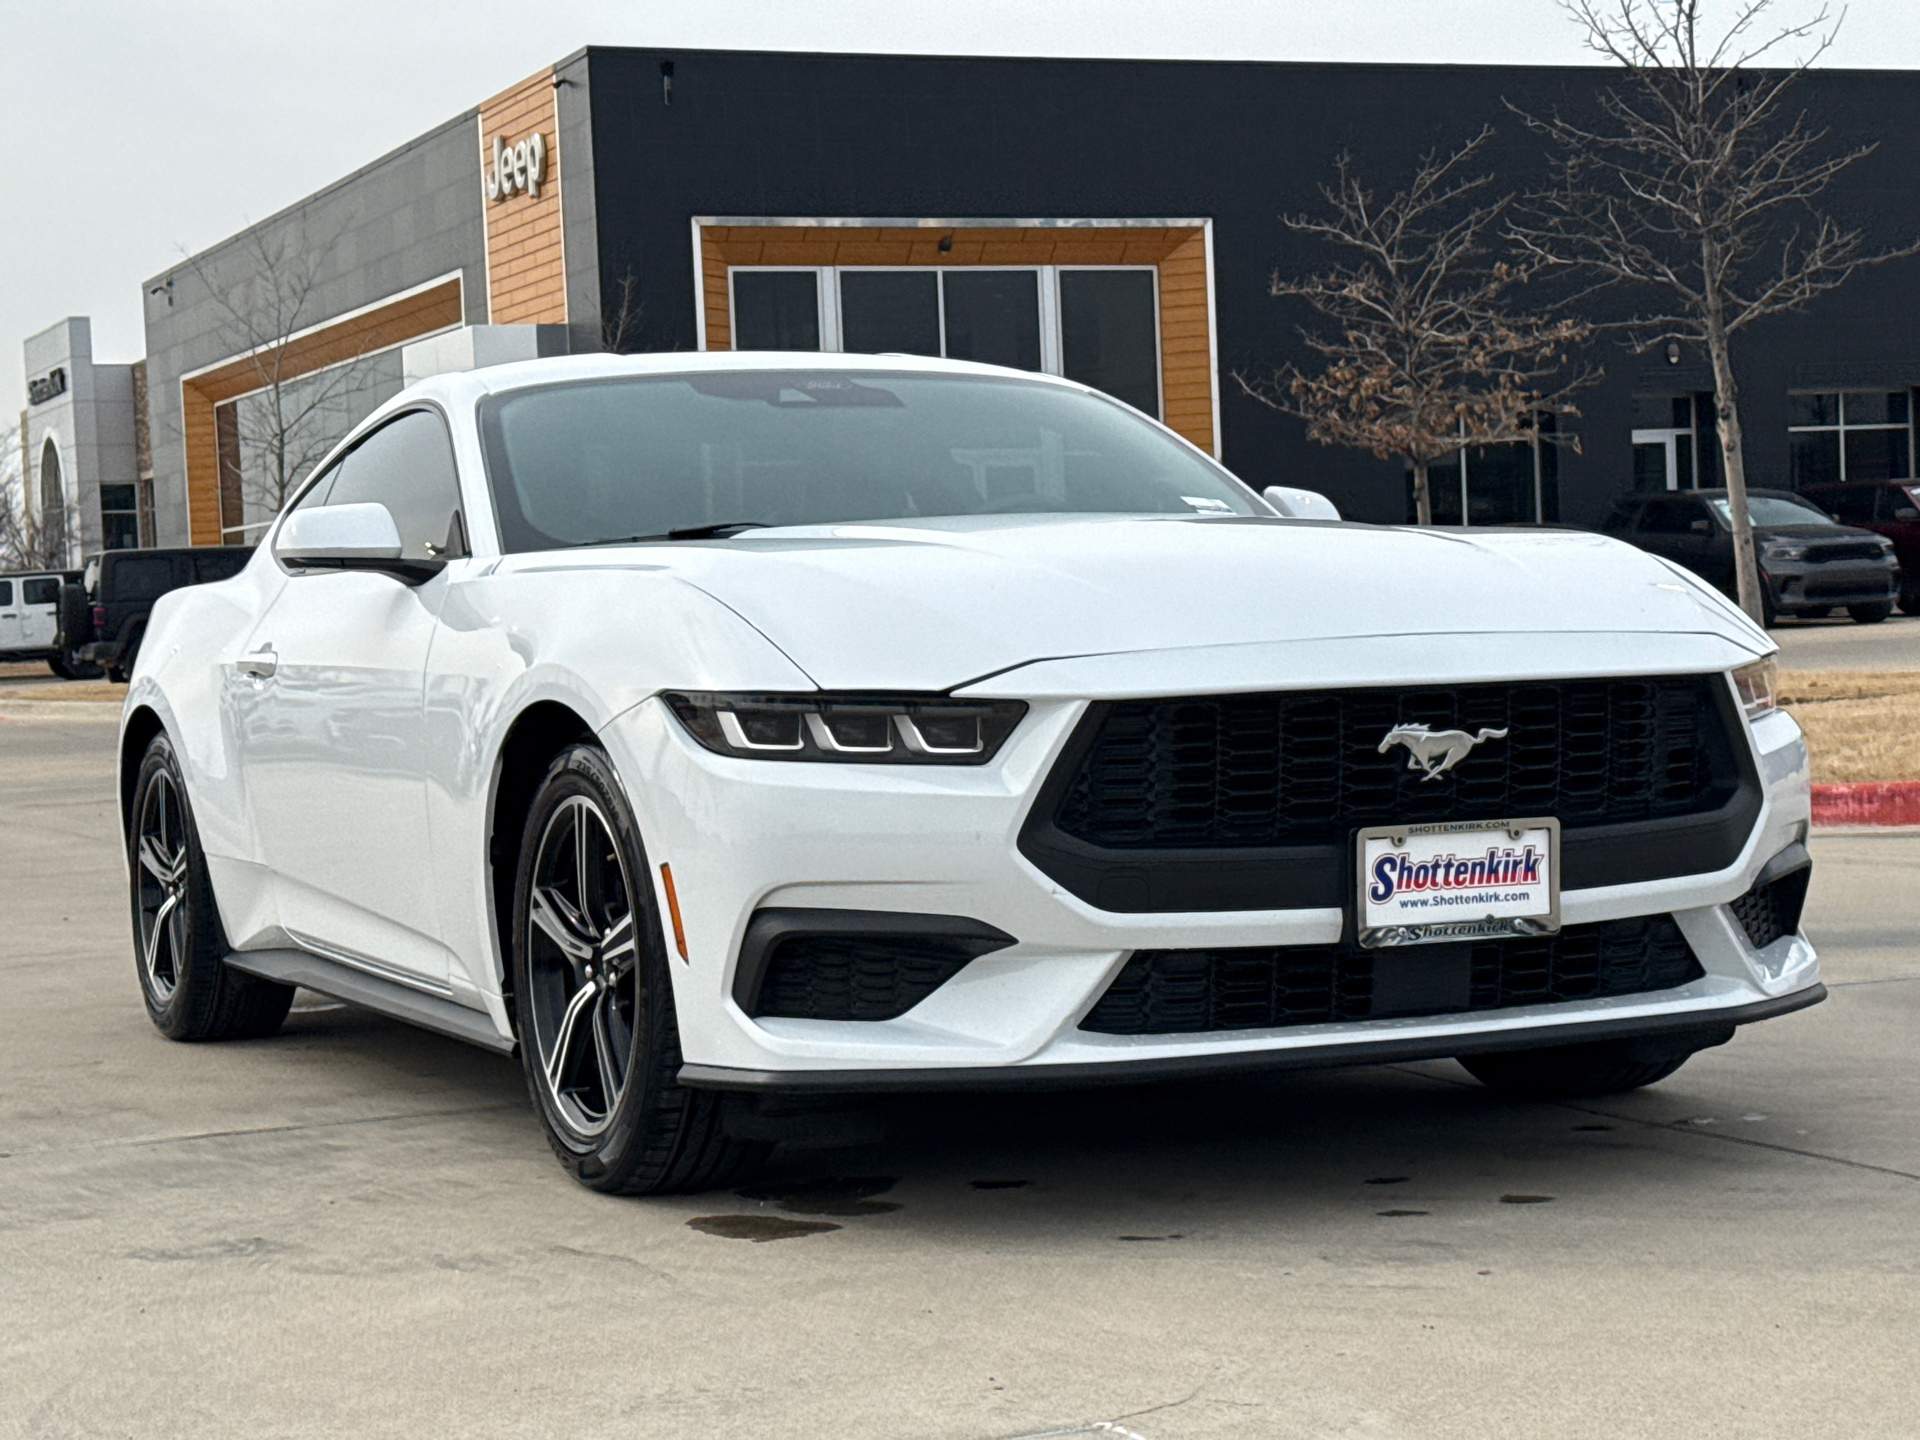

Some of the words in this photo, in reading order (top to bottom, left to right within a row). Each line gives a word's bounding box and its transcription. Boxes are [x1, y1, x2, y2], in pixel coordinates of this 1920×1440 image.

[486, 133, 544, 200] Jeep
[1408, 821, 1510, 834] SHOTTENKIRK.COM
[1369, 847, 1542, 903] Shottenkirk
[1399, 891, 1530, 909] www.Shottenkirk.com
[1407, 920, 1509, 940] Shottenkirk
